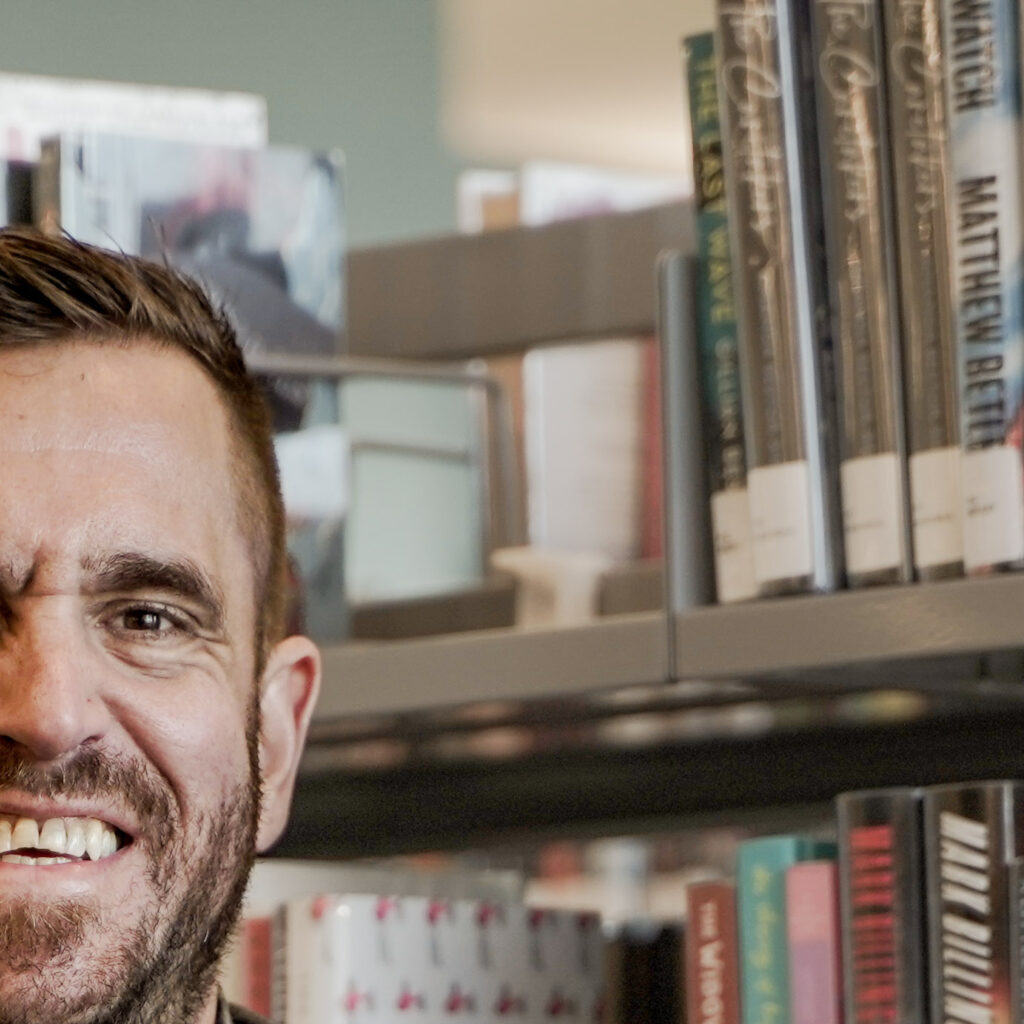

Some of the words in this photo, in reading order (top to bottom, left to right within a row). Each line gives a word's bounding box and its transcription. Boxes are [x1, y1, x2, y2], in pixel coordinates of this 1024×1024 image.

[695, 55, 720, 122] THE
[699, 131, 727, 214] LAST
[707, 223, 737, 324] WAVE
[958, 175, 1004, 345] MATTHEW
[850, 825, 895, 906] MARK
[939, 811, 991, 915] MARK
[700, 901, 718, 937] THE
